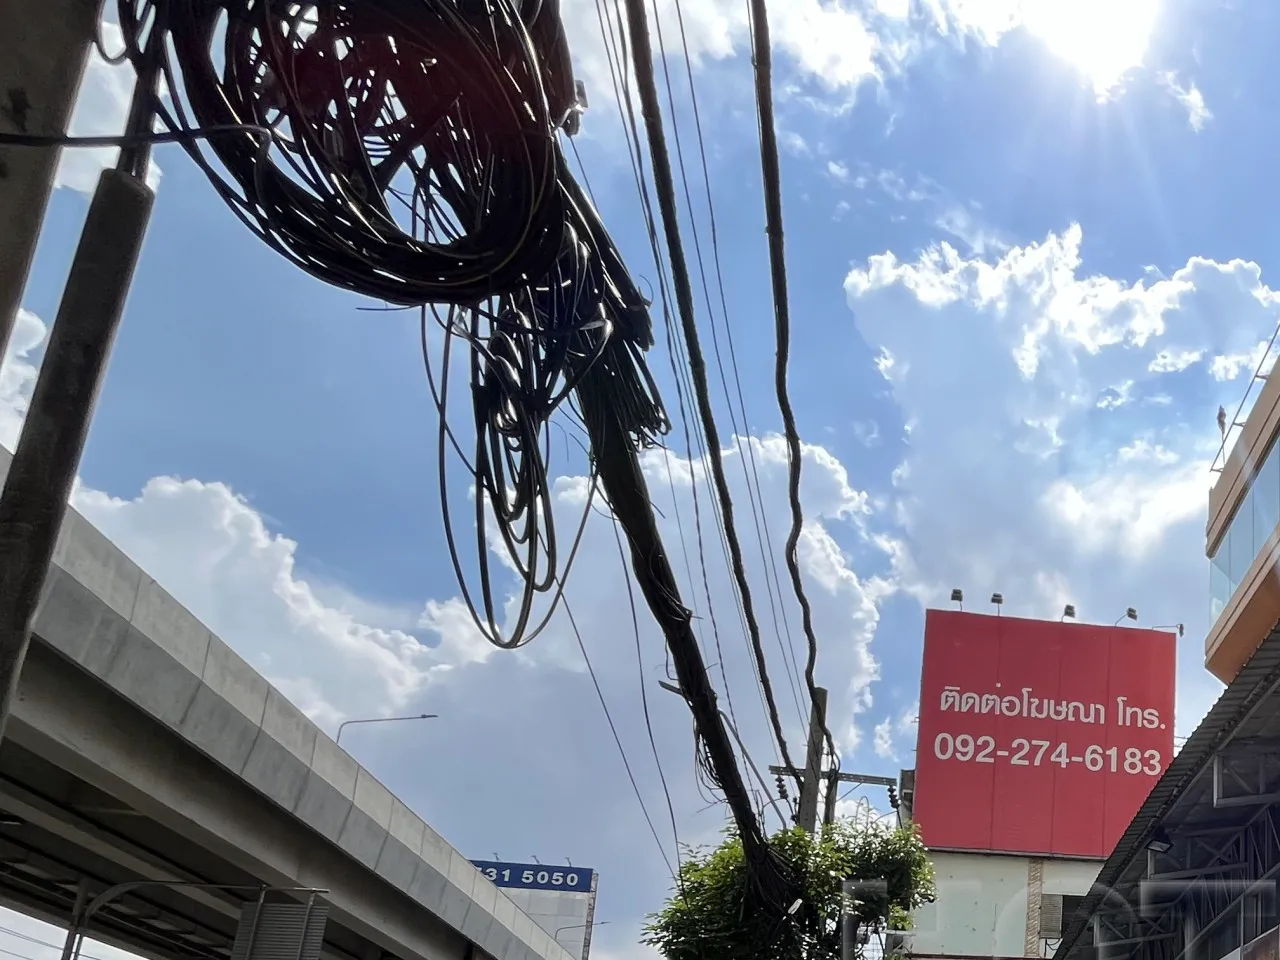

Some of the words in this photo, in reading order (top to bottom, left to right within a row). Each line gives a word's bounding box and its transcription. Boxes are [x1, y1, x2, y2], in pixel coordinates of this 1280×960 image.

[940, 683, 1105, 724] ติดต่อโฆษณา
[1117, 697, 1166, 729] โทร.
[934, 732, 1161, 775] 092-274-6183
[521, 870, 578, 886] 5050
